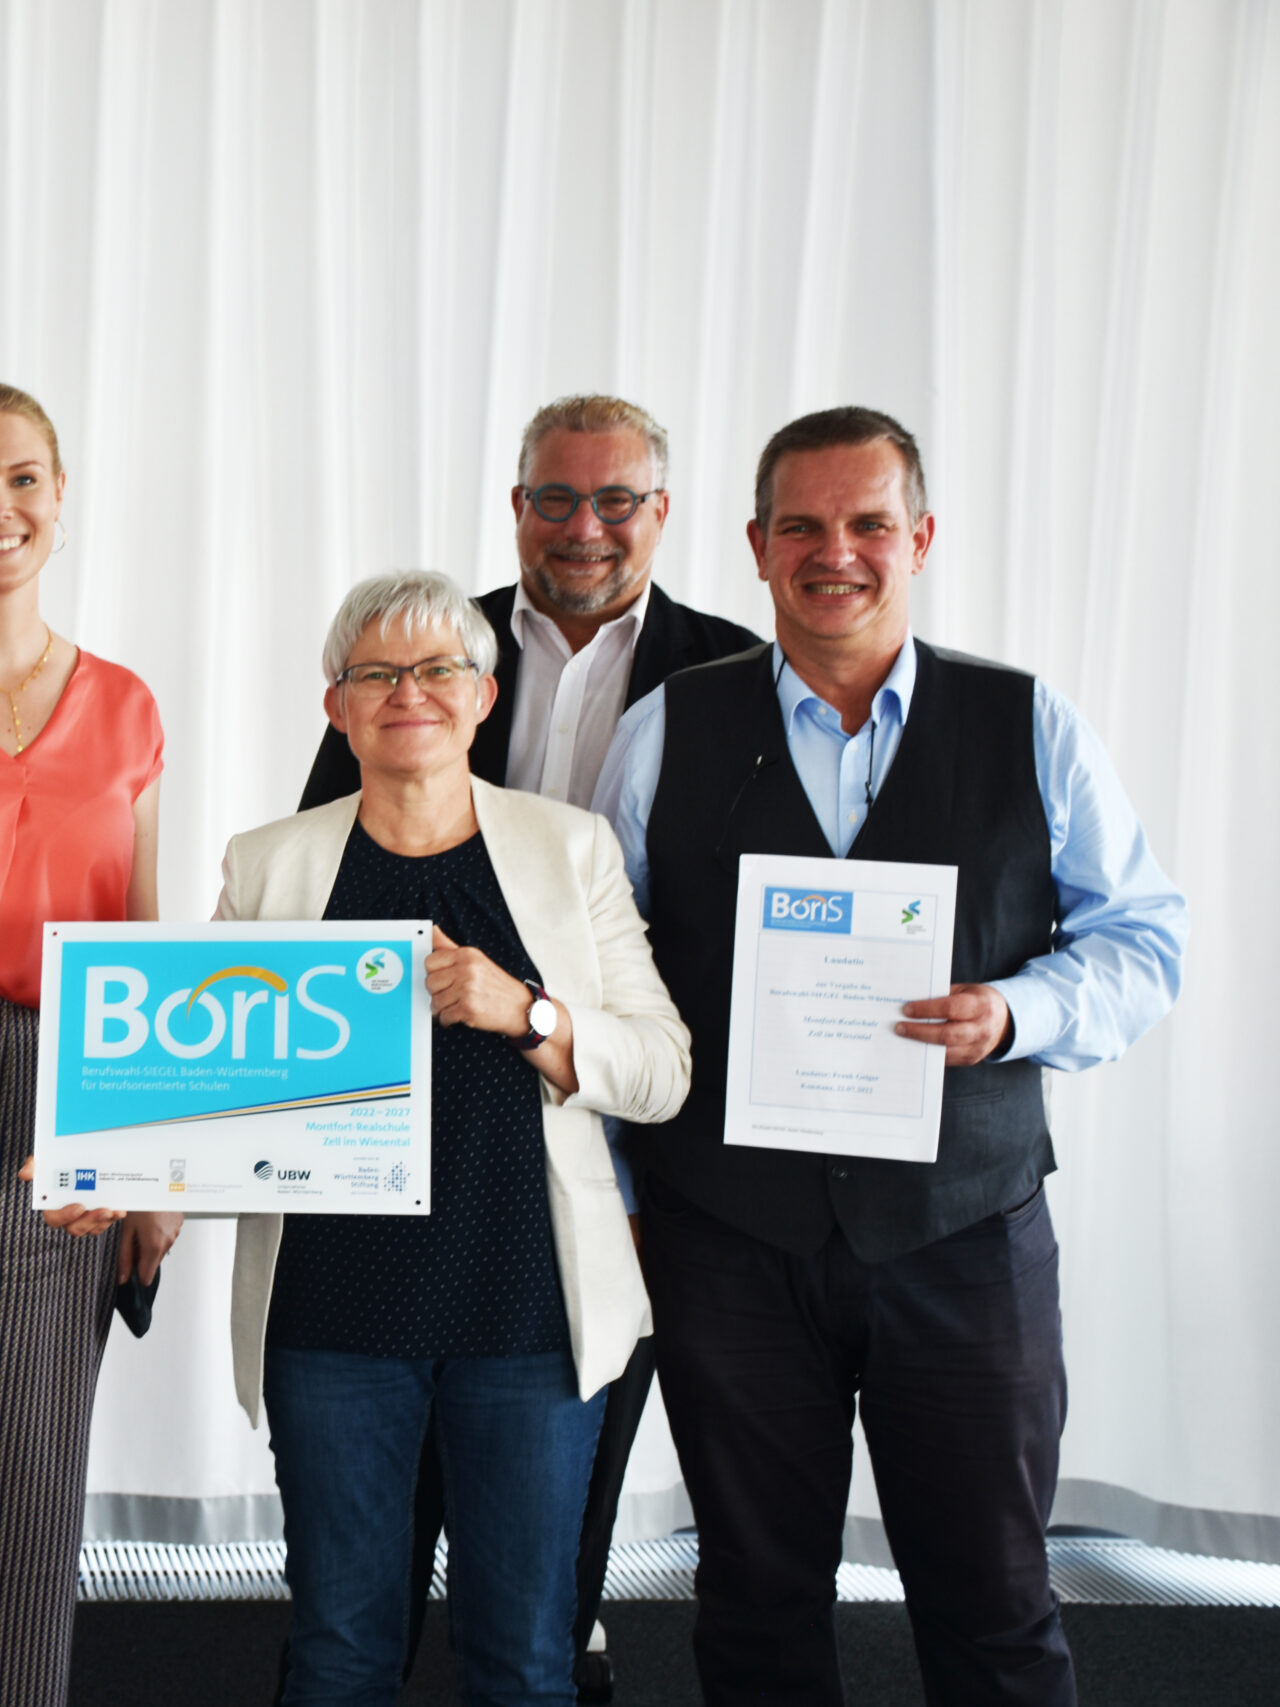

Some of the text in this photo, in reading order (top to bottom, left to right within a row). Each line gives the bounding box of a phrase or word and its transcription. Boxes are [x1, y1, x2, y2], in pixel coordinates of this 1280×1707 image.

[771, 892, 843, 923] BoriS
[83, 965, 351, 1060] BoriS
[81, 1066, 289, 1080] Berufswahl-SIEGEL Baden-Württemberg
[81, 1080, 230, 1091] für berufsorientierte Schulen
[322, 1136, 411, 1147] Zell im Wiesental
[77, 1170, 95, 1182] IHK
[277, 1169, 311, 1181] UBW
